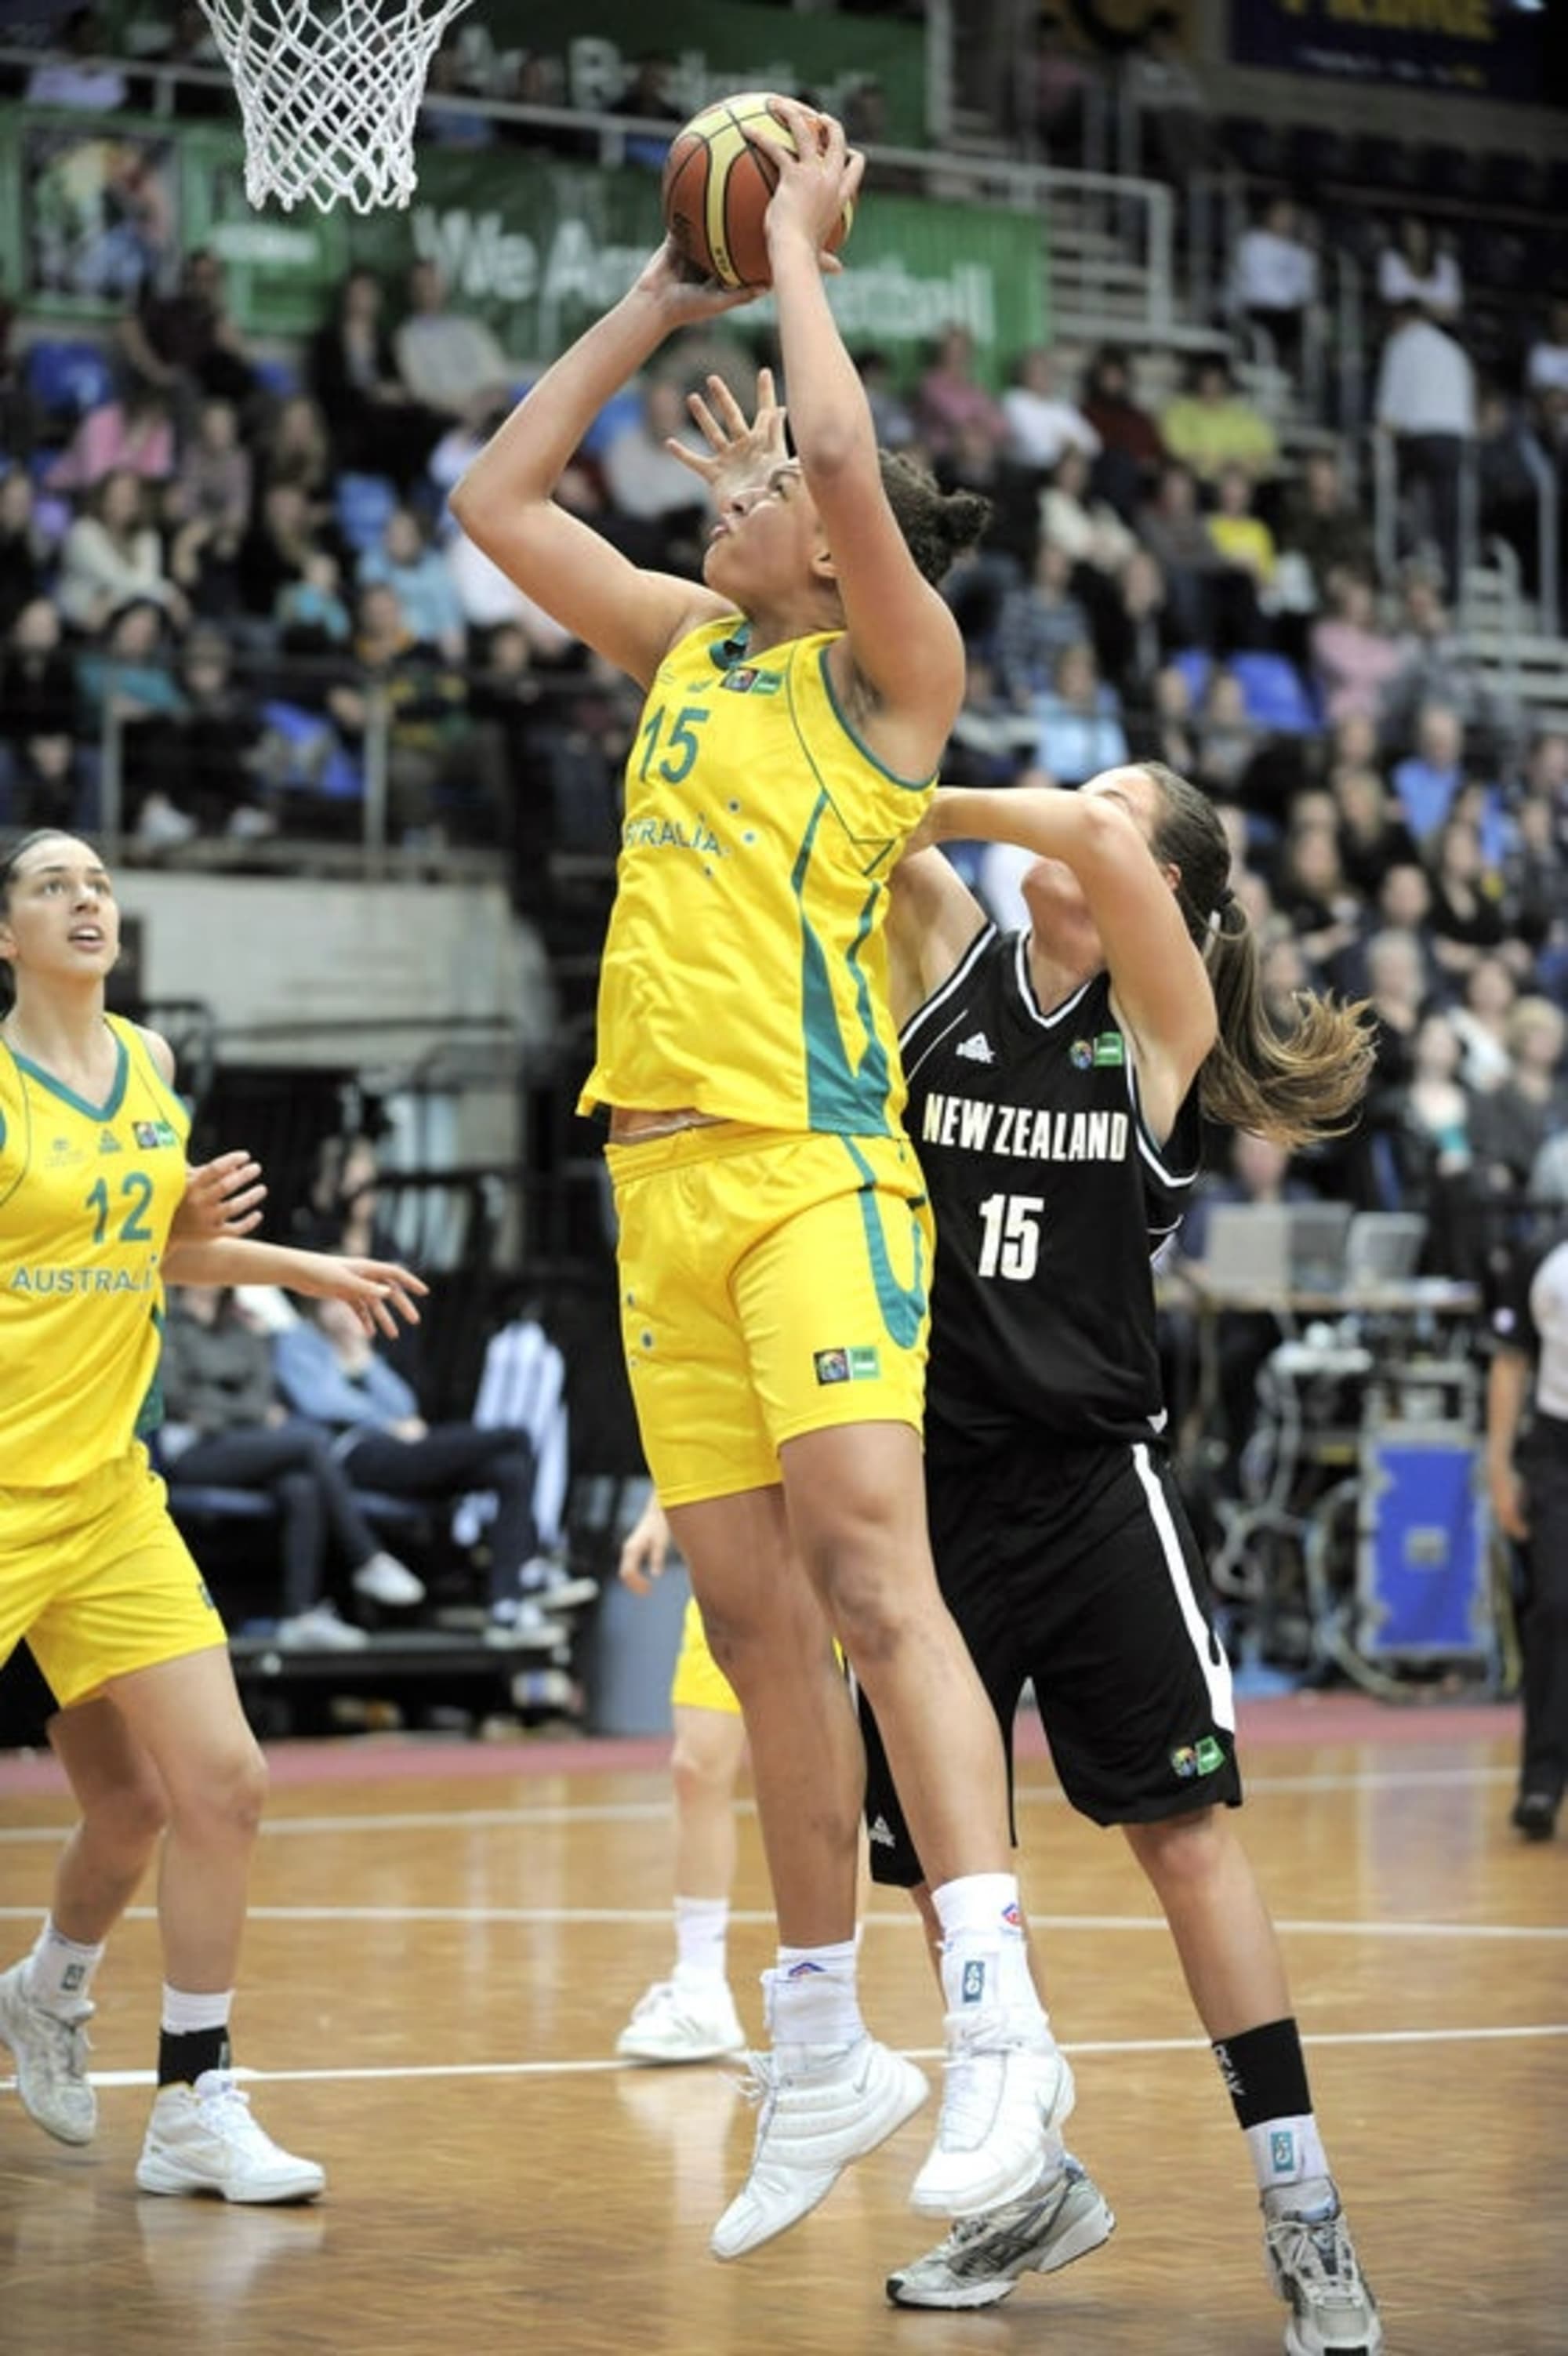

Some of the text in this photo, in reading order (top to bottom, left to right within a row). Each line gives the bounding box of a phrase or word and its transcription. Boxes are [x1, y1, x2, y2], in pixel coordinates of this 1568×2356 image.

[638, 704, 710, 785] 15
[922, 1093, 1128, 1162] NEW ZEALAND
[85, 1171, 154, 1244] 12
[978, 1193, 1044, 1281] 15
